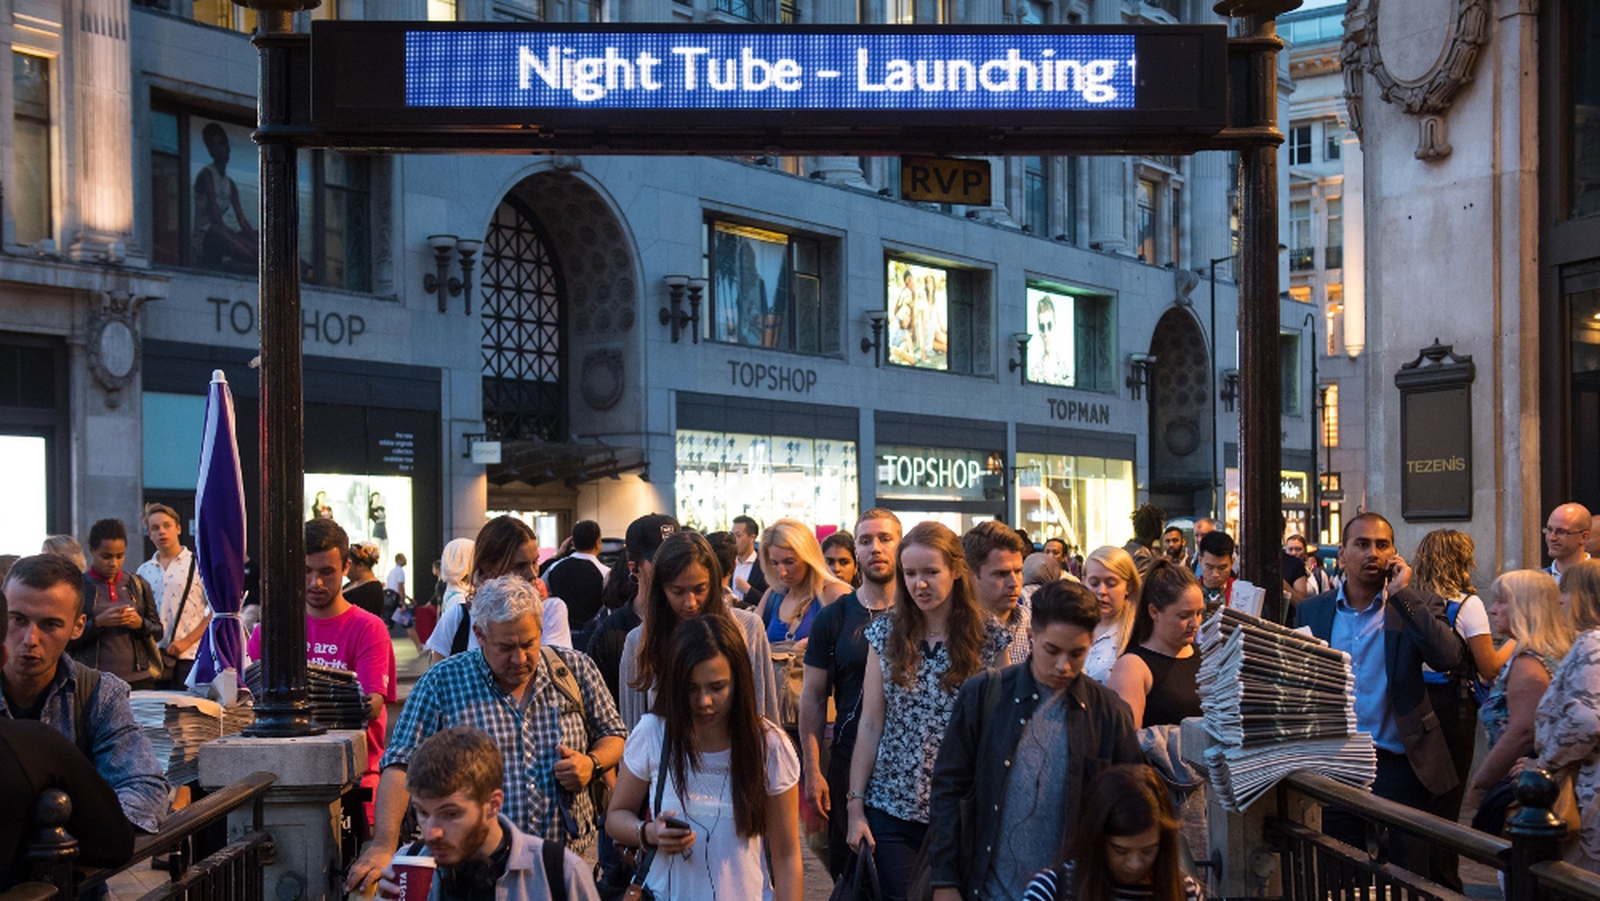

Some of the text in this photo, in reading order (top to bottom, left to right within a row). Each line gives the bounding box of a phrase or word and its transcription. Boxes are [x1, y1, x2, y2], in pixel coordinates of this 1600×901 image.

[519, 46, 662, 101] Night
[671, 47, 803, 91] Tube
[857, 47, 1119, 103] Launching
[911, 165, 983, 196] RVP
[206, 297, 366, 346] TOHOP
[727, 360, 818, 394] TOPSHOP
[1047, 398, 1110, 425] TOPMAN
[883, 455, 981, 489] TOPSHOP
[313, 642, 338, 655] are
